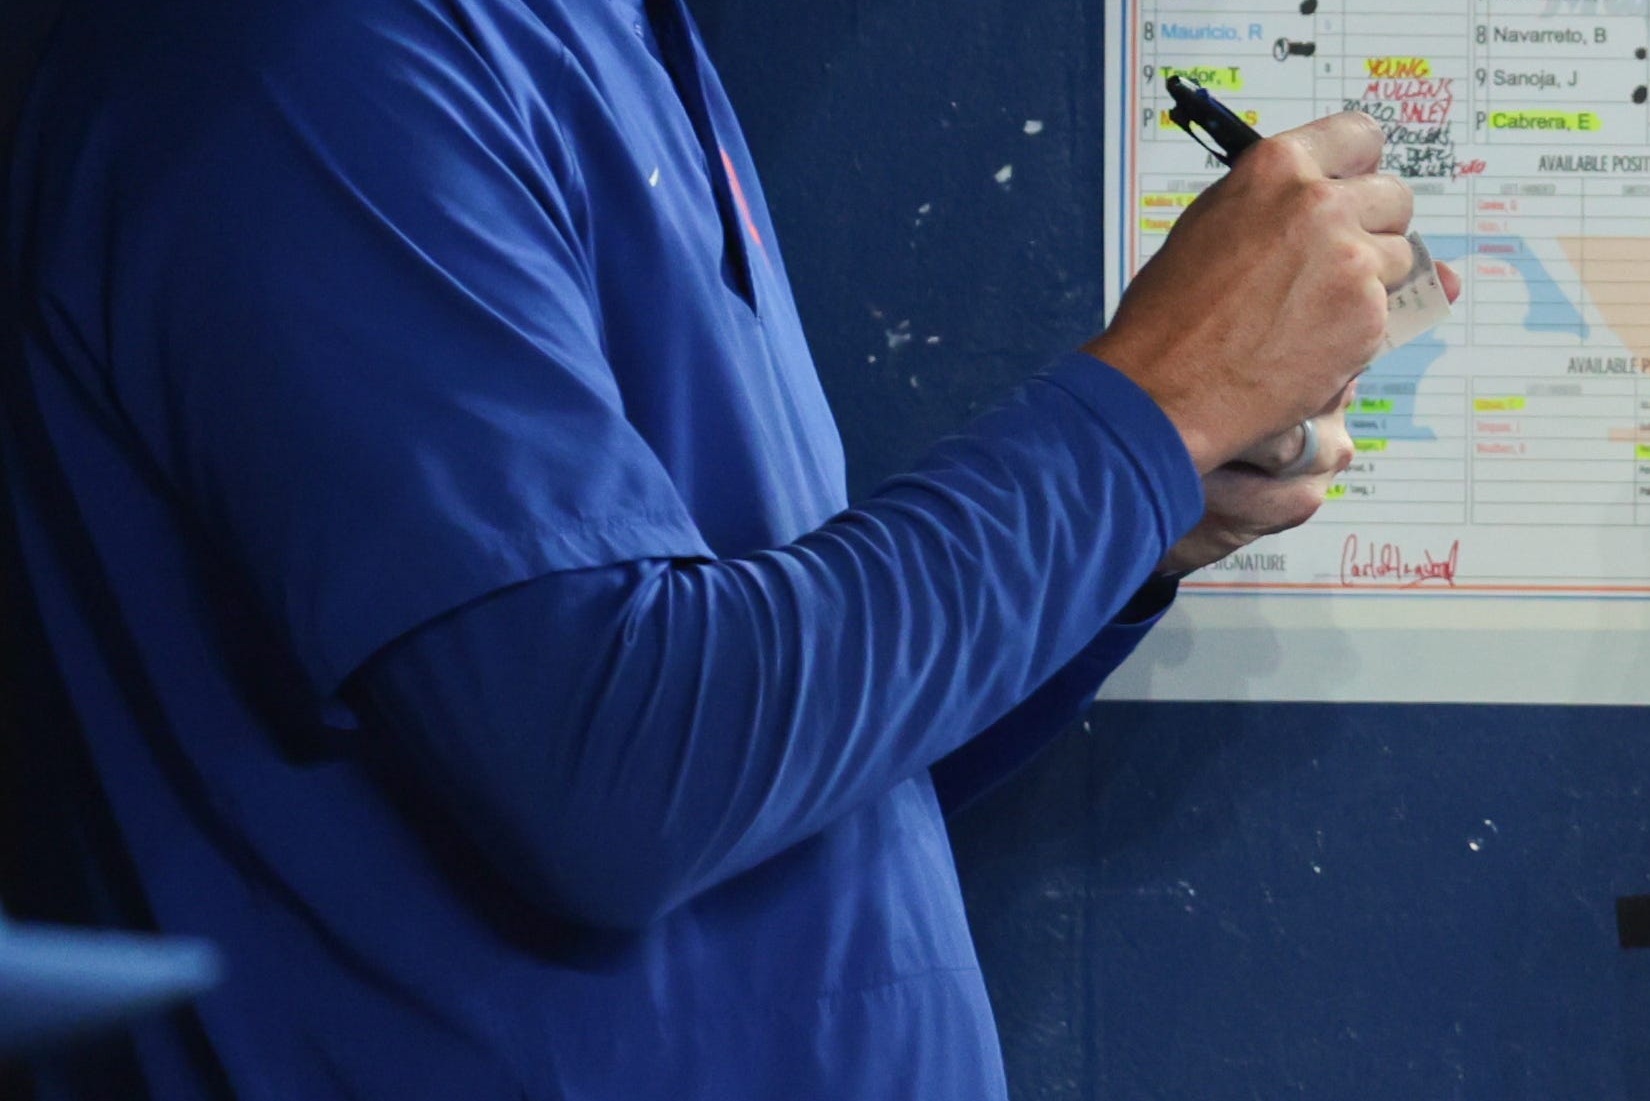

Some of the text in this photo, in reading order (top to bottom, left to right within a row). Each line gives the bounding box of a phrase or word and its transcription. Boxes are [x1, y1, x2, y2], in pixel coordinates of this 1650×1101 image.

[1144, 22, 1263, 41] 8 Mauricio, R
[1476, 25, 1487, 44] 8
[1494, 27, 1588, 45] Navarreto,
[1594, 28, 1607, 43] B
[1143, 65, 1154, 84] 9
[1228, 67, 1240, 83] T
[1367, 57, 1429, 79] YOUNG
[1476, 68, 1578, 90] 9 Sanoja, J
[1362, 77, 1454, 101] MULLINS
[1143, 108, 1154, 127] P
[1476, 112, 1591, 132] P Cabrera, E
[1538, 155, 1608, 172] AVAILABLE
[1567, 357, 1636, 374] AVAILABLE
